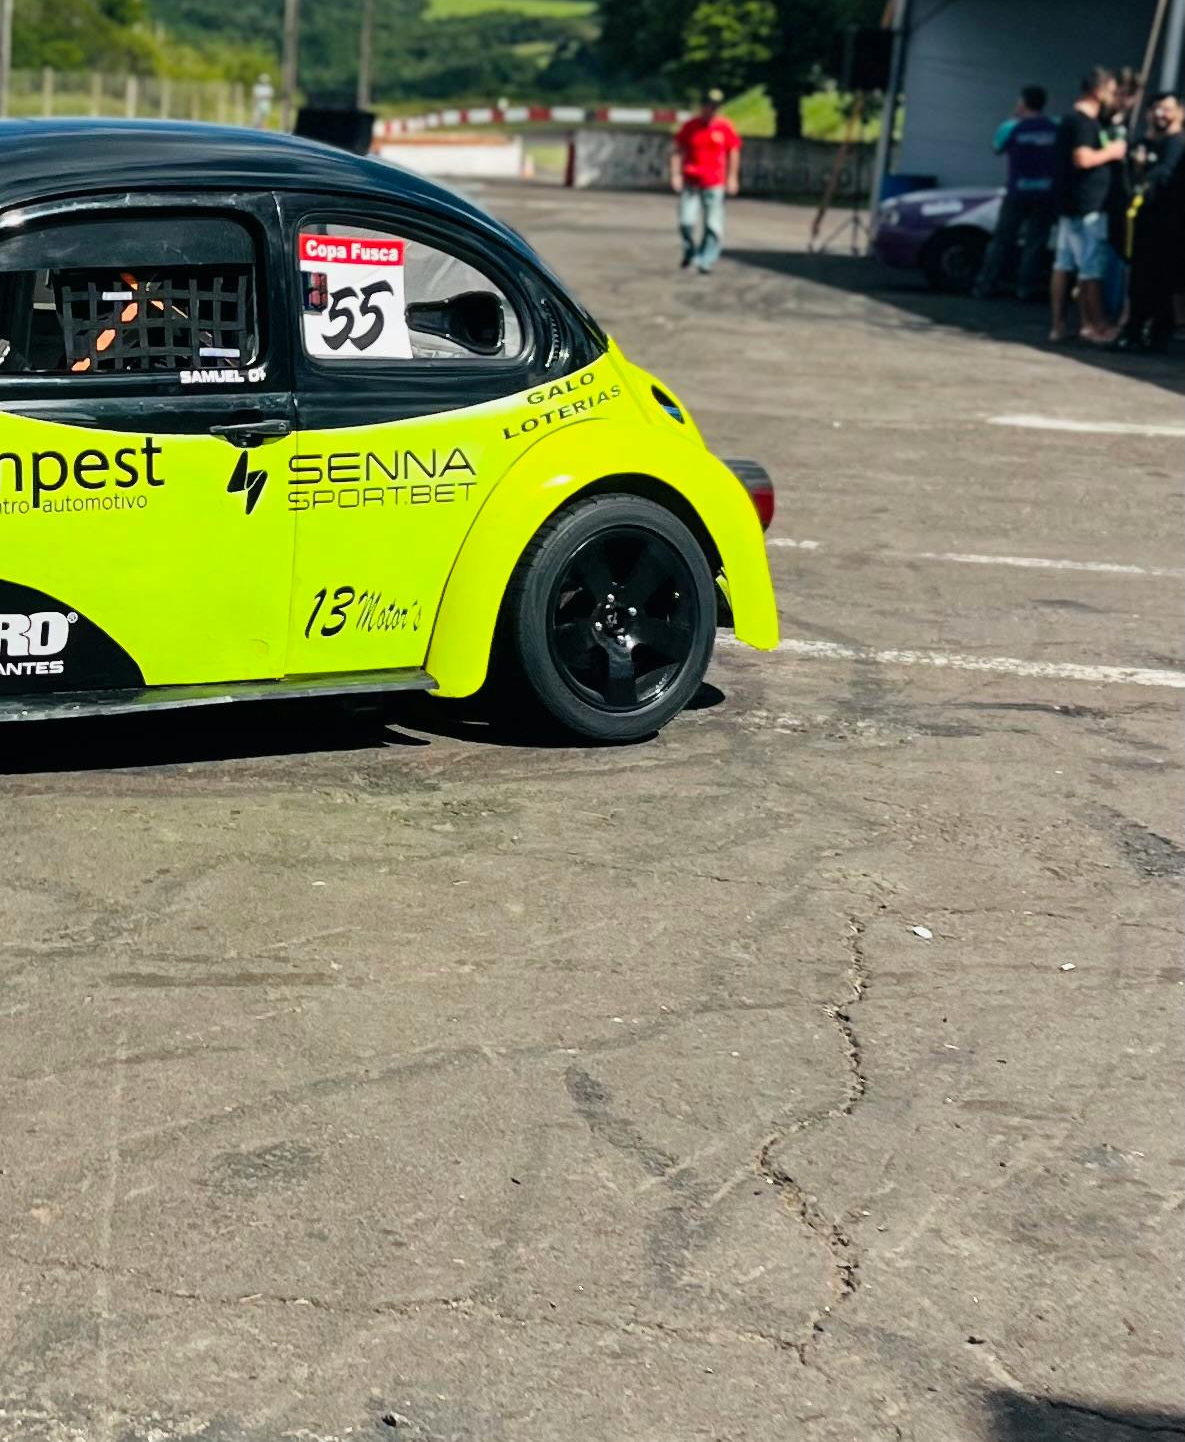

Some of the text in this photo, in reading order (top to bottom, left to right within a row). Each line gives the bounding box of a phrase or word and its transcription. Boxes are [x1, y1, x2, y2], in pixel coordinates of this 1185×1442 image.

[305, 239, 399, 261] Copa Fusca
[321, 279, 394, 351] 55
[179, 369, 244, 383] SAMUEL
[527, 372, 594, 404] GALO
[503, 385, 621, 439] LOTERIAS
[288, 448, 477, 484] SENNA
[44, 493, 148, 513] automotivo
[305, 586, 355, 639] 13
